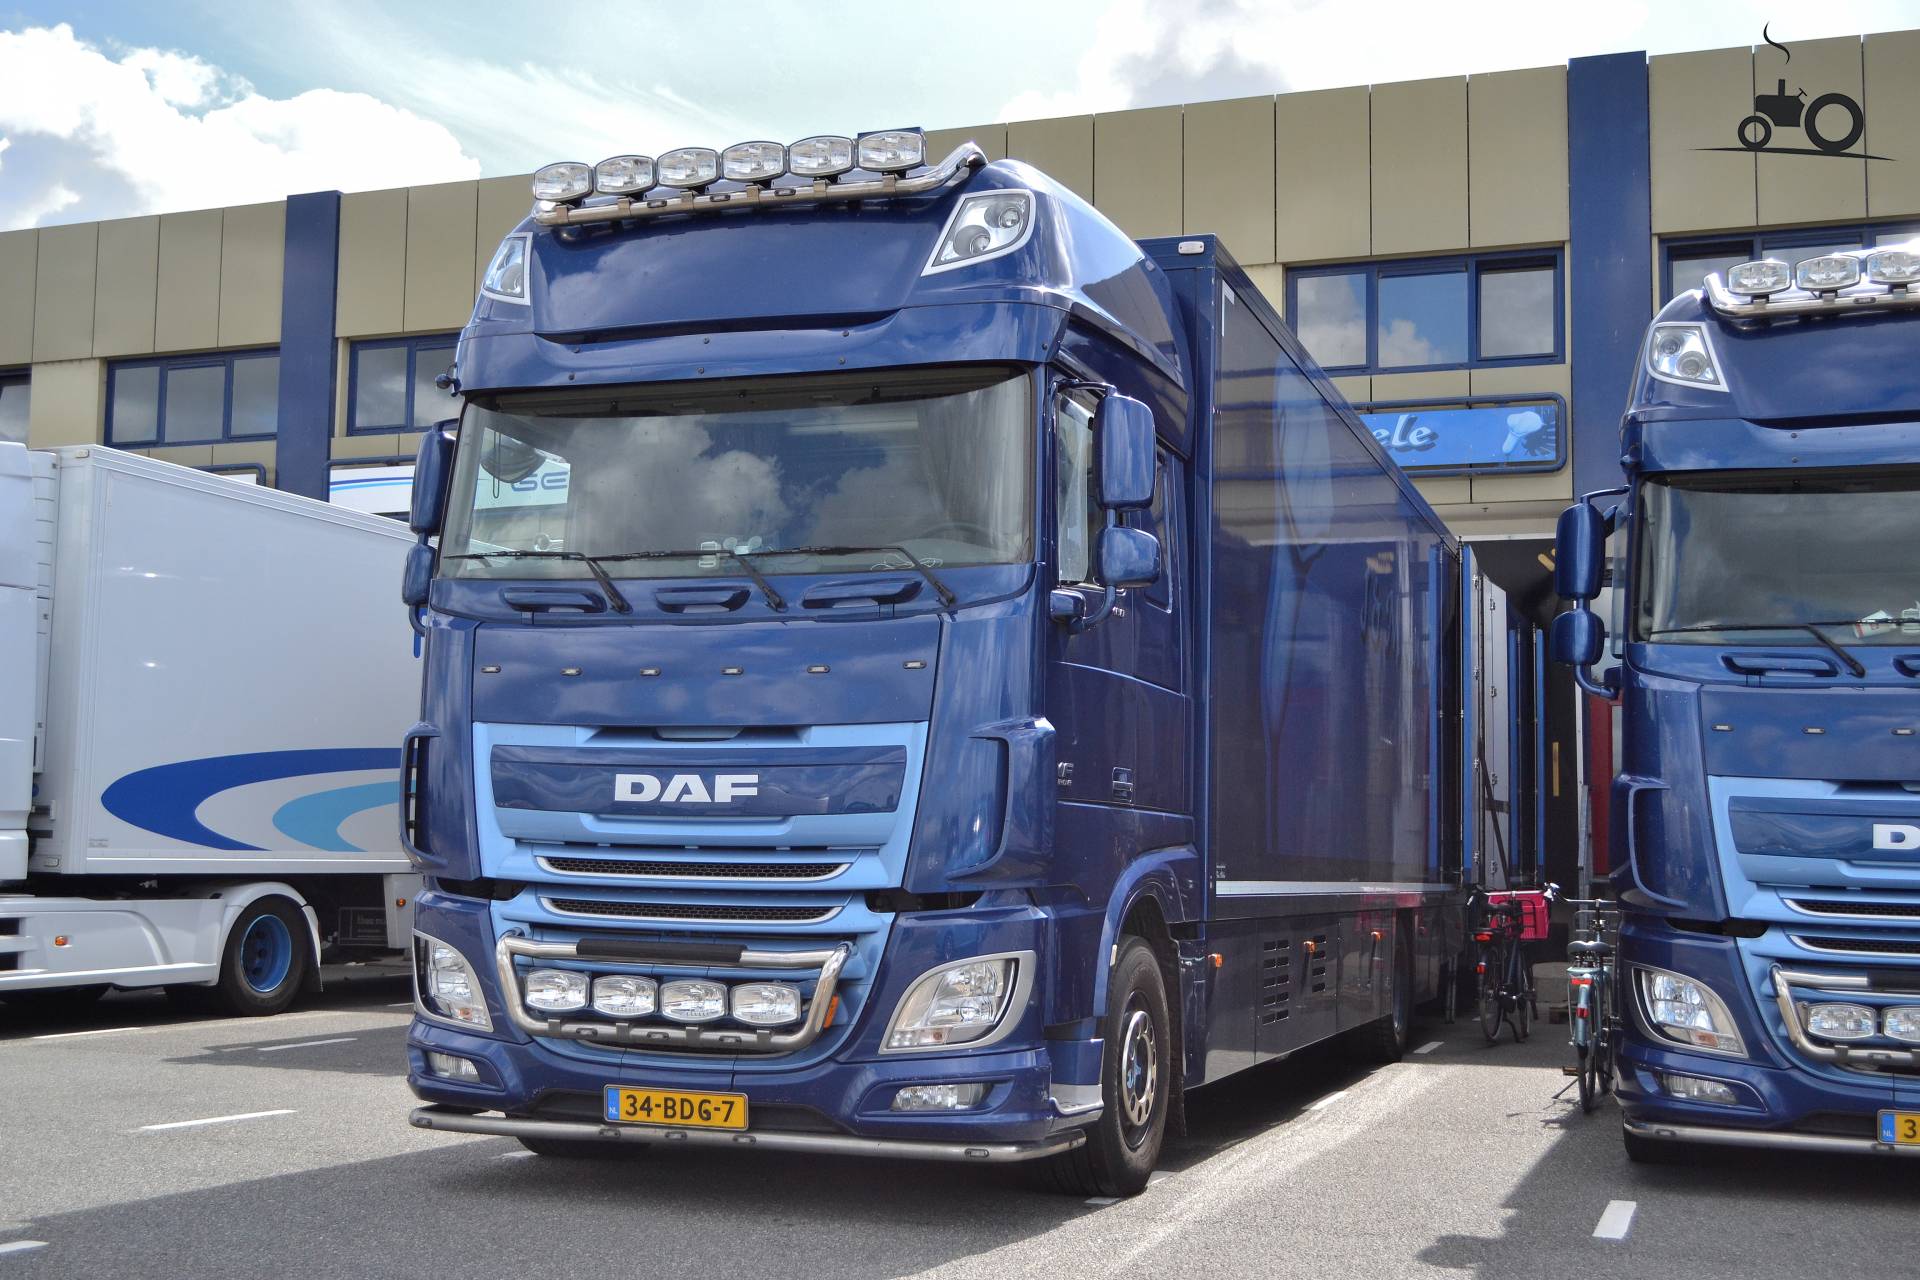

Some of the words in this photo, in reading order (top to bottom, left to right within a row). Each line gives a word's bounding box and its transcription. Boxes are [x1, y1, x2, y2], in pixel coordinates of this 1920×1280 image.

[614, 773, 759, 803] DAF
[608, 1105, 618, 1115] NL
[624, 1093, 736, 1123] 34-BDG-7
